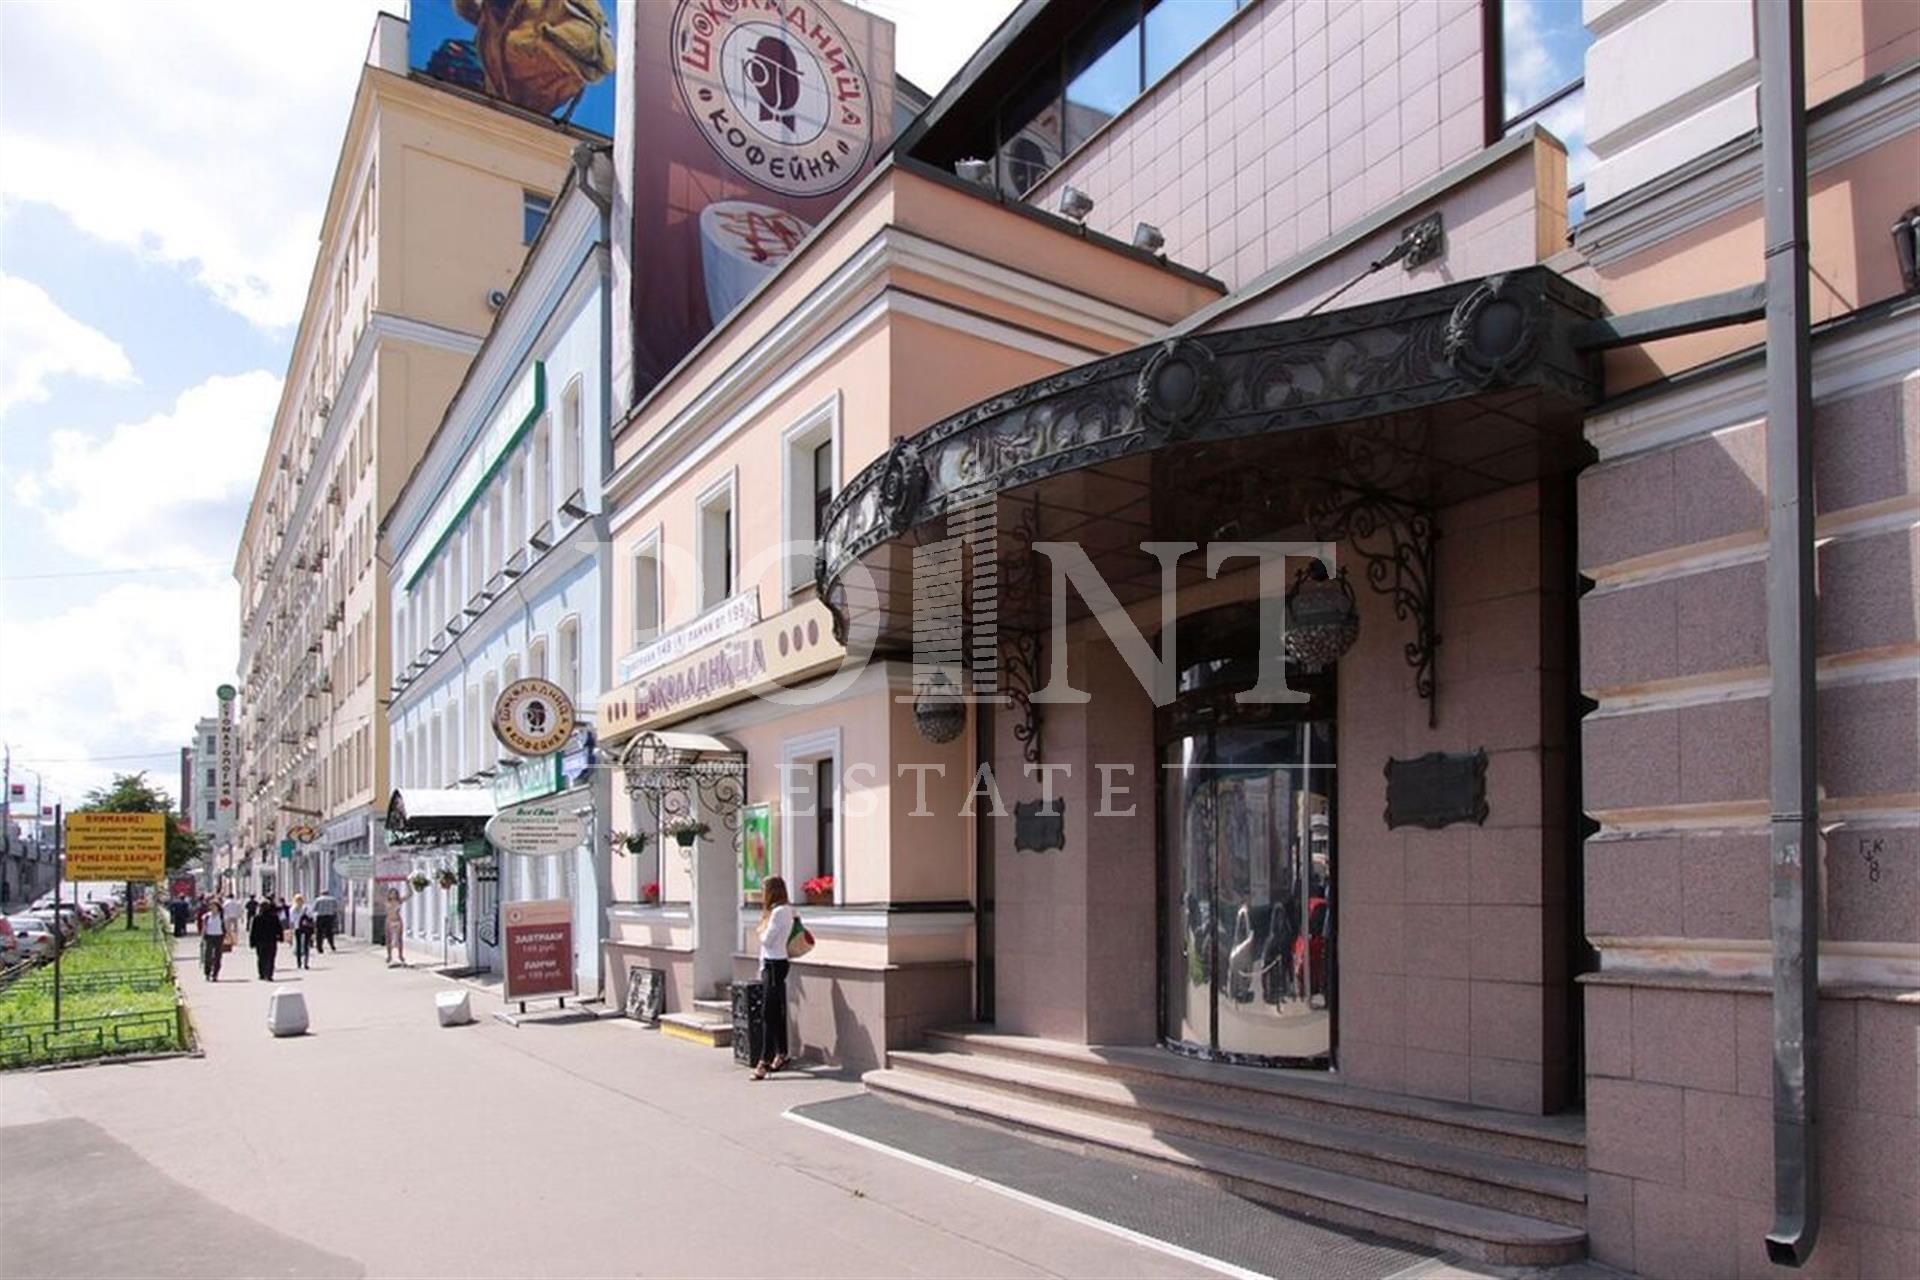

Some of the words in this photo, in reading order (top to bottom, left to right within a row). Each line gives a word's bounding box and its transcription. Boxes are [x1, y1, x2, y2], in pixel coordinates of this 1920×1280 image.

[709, 108, 840, 181] КОФЕЙНЯ
[635, 638, 767, 721] ШОКОЛАДНИЦА
[222, 702, 231, 795] СТОМАТОЛОГИЯ
[515, 932, 563, 944] ЗАВТРАКИ
